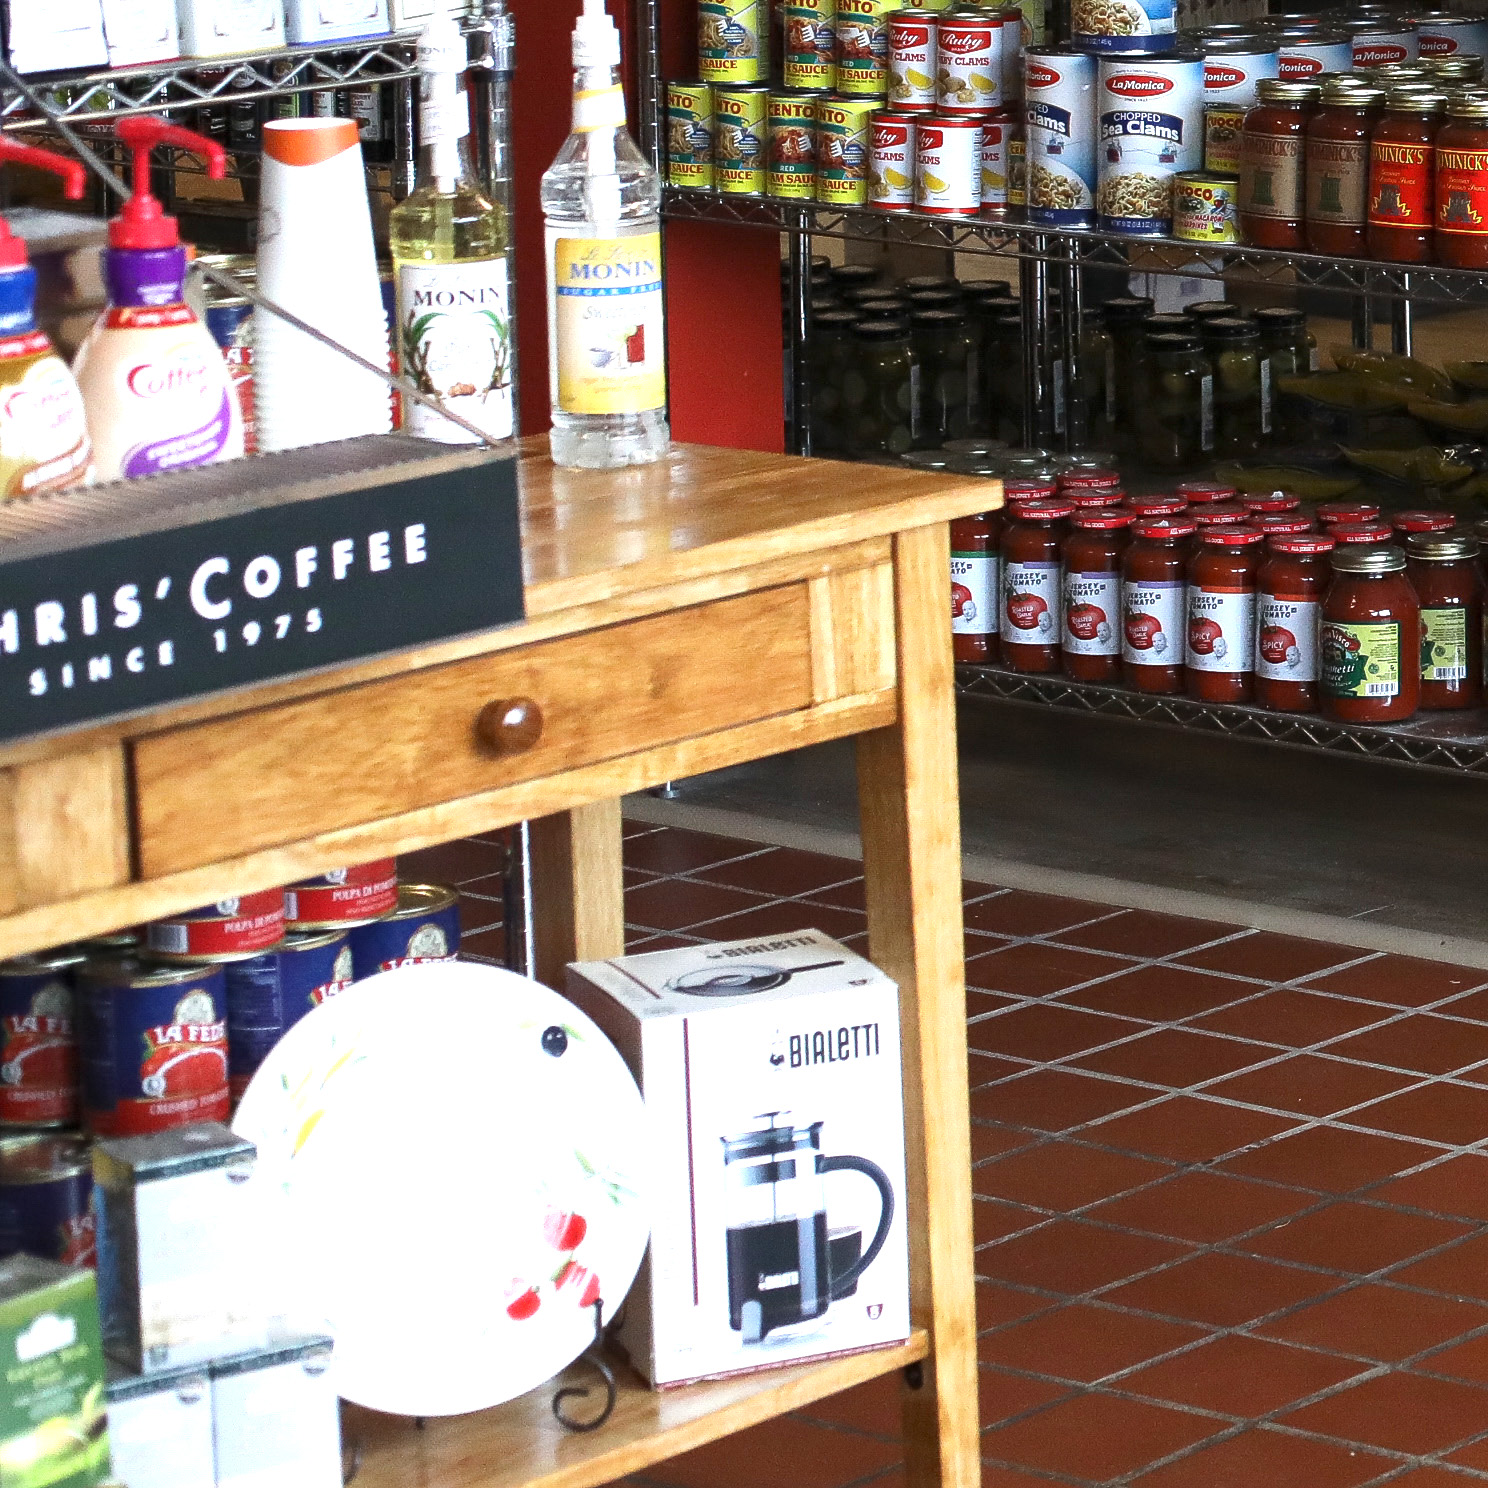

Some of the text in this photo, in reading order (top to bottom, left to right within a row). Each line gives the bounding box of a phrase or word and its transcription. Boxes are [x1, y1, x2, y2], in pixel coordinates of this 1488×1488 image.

[941, 32, 984, 50] Ruby
[894, 52, 926, 63] CLAMS
[954, 57, 990, 66] CLAMS
[703, 58, 738, 69] SAUCE
[791, 64, 828, 75] SAUCE
[847, 69, 885, 80] SAUCE
[1113, 111, 1161, 123] CHOPPED
[1102, 120, 1179, 141] Sea Clams
[873, 152, 905, 162] CLAMS
[1372, 145, 1424, 165] OMINICK'S
[671, 163, 704, 174] SAUCE
[780, 164, 795, 173] RED
[719, 170, 753, 180] SAUCE
[822, 180, 857, 190] SAUCE
[570, 260, 656, 280] MONIN
[414, 287, 500, 306] MONIN
[562, 286, 613, 296] SUGAR
[1011, 572, 1040, 580] JERSEY
[1009, 578, 1042, 586] TOMATO
[1070, 582, 1100, 591] JERSEY
[0, 522, 428, 654] HRIS' COFFEE
[1069, 588, 1100, 597] TOMATO
[1127, 592, 1155, 600] JERSEY
[1190, 596, 1217, 604] JERSEY
[1126, 598, 1156, 606] TOMATO
[1263, 604, 1290, 612] JERSEY
[1190, 631, 1211, 642] SPICY
[1262, 640, 1284, 652] SPICY
[28, 607, 323, 697] SINCE 1975
[722, 936, 818, 958] BIALETTI
[11, 1016, 40, 1033] LA
[153, 1025, 182, 1043] LA
[788, 1022, 880, 1069] BIALETTI
